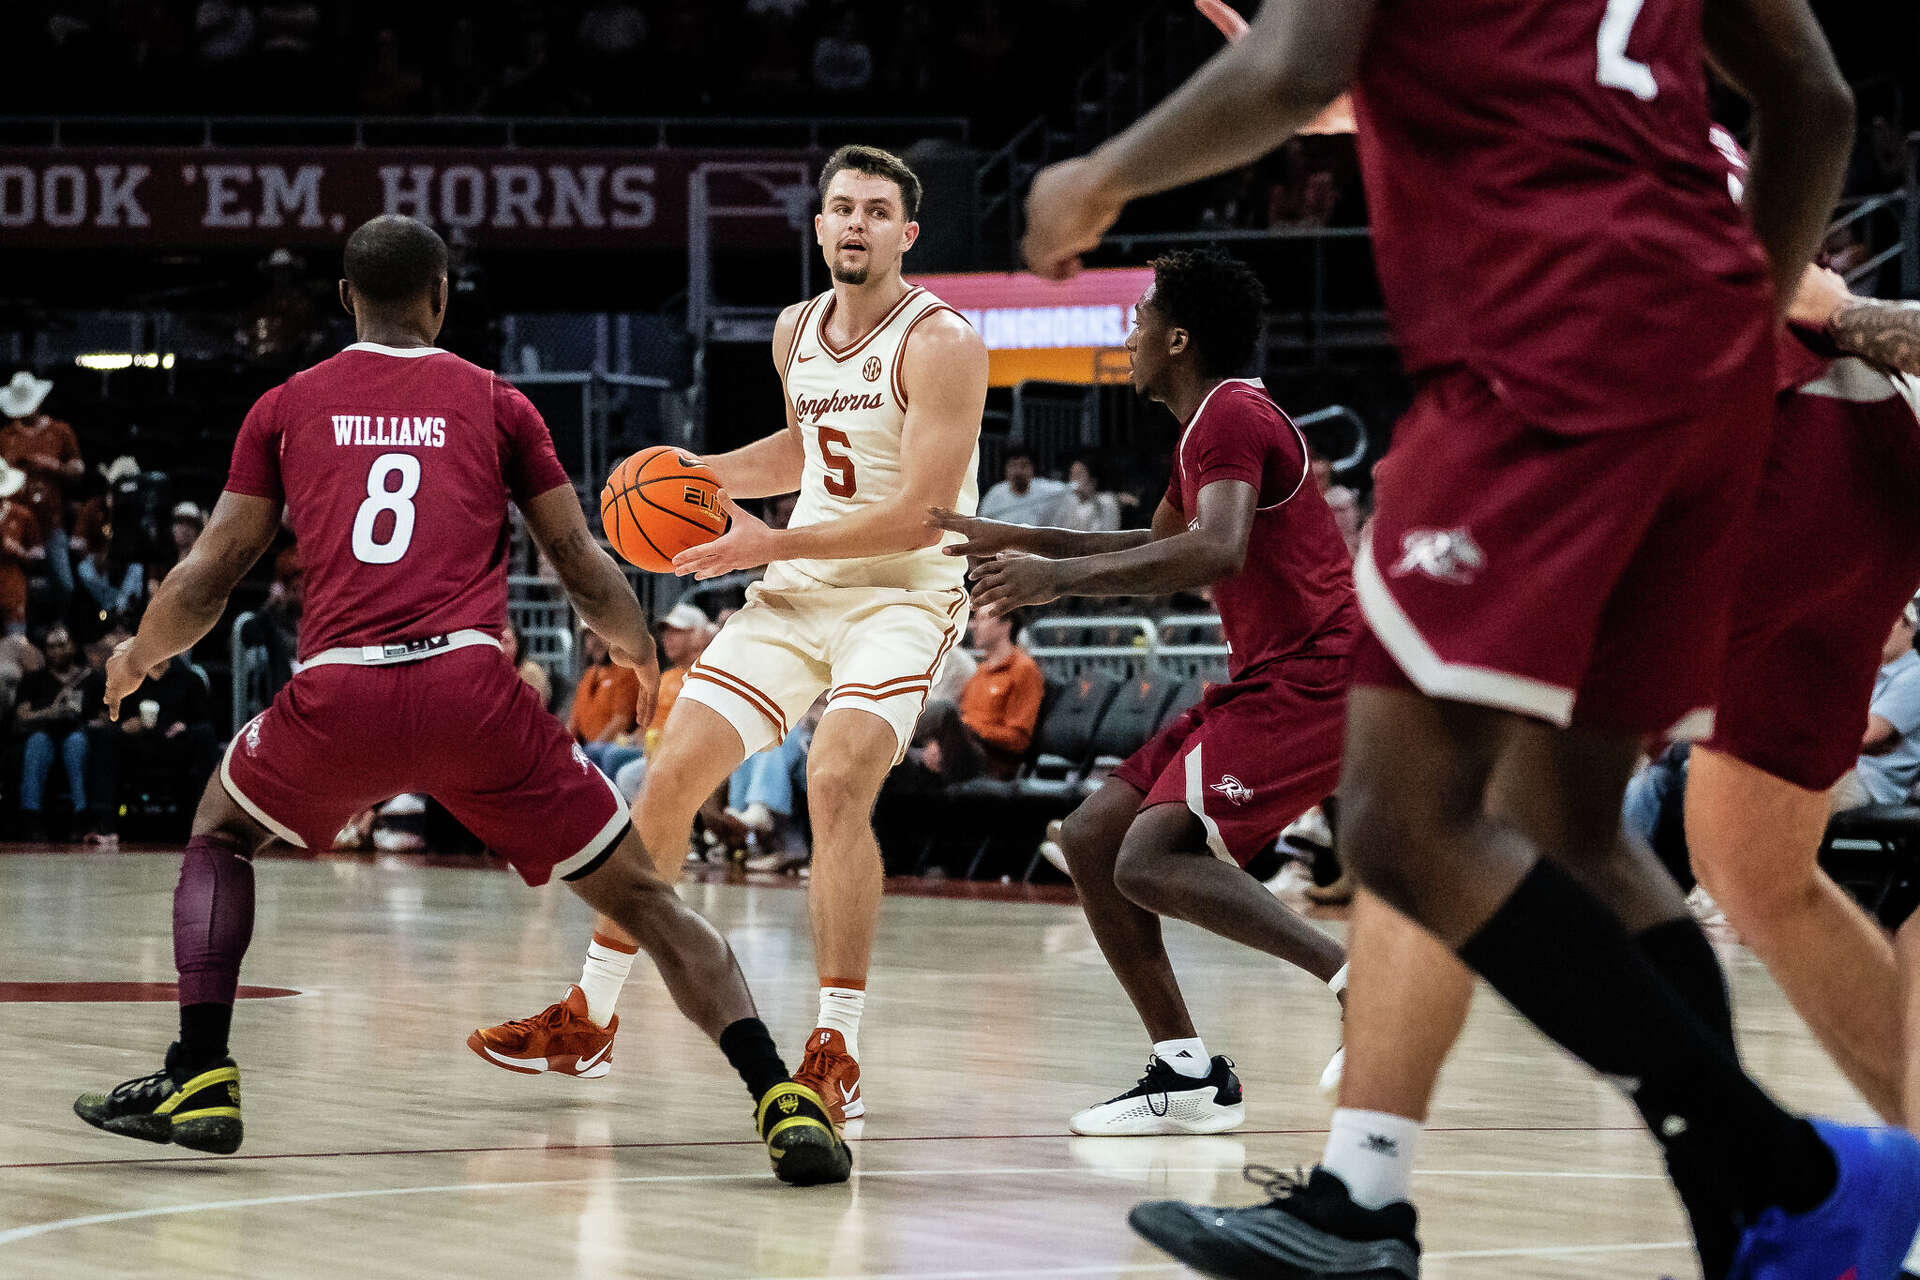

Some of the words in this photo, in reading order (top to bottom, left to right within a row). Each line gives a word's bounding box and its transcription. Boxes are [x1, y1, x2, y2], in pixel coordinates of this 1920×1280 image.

[0, 165, 150, 227] OOK
[378, 165, 655, 228] HORNS
[863, 357, 882, 382] SEC
[331, 415, 447, 448] WILLIAMS
[817, 425, 858, 499] 5
[352, 452, 422, 564] 8
